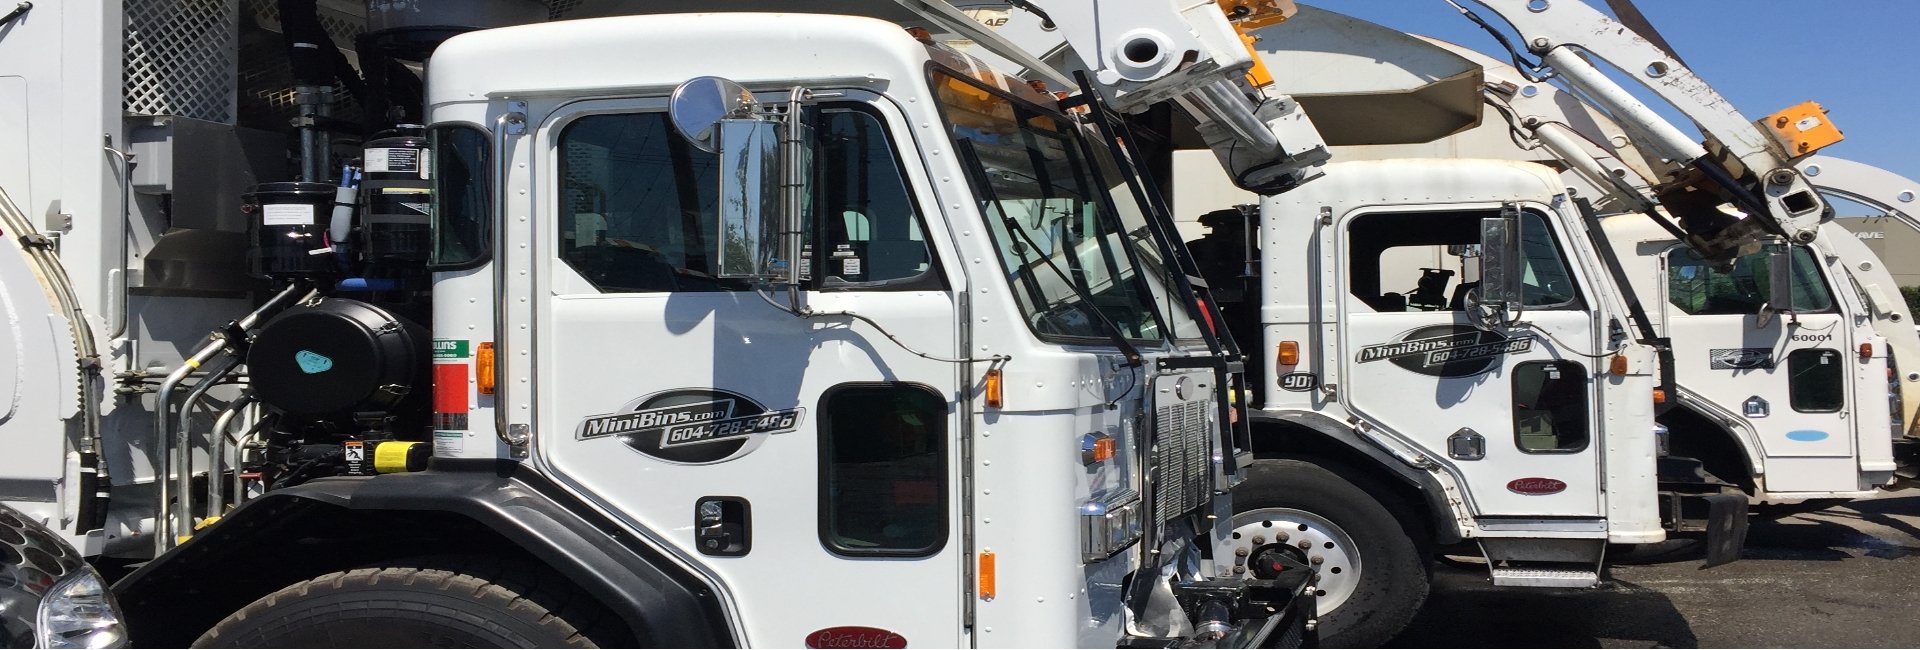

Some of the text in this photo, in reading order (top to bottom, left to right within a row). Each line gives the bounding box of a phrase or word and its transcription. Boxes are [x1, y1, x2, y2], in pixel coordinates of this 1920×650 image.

[1791, 334, 1833, 342] 60001
[1284, 375, 1314, 388] 901
[670, 413, 794, 443] 604-728-5486
[817, 631, 898, 649] Peterbilt
